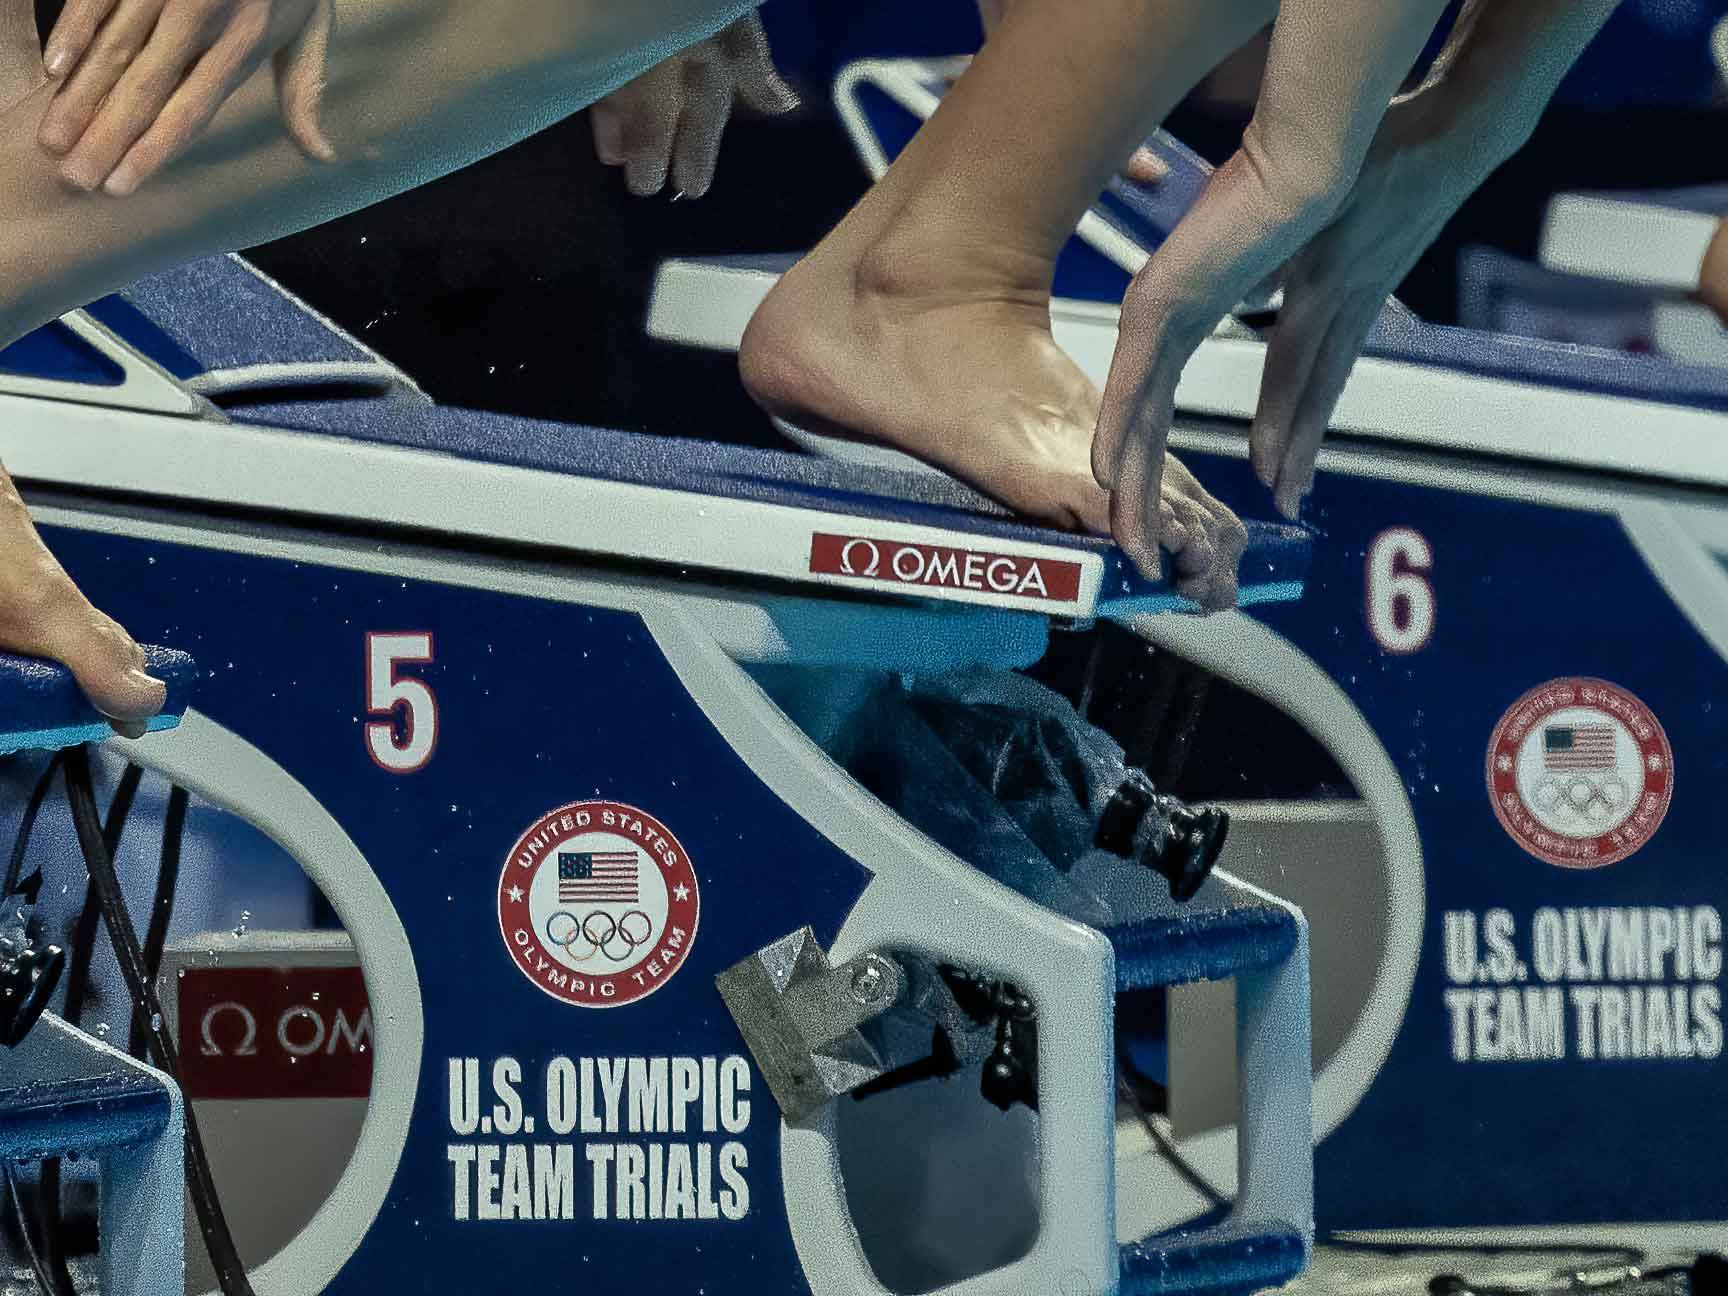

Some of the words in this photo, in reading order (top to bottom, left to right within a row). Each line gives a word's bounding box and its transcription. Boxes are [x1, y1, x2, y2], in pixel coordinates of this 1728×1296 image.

[891, 546, 1049, 598] OMEGA
[1366, 526, 1435, 654] 6
[363, 631, 439, 773] 5
[517, 810, 592, 868] UNITED
[601, 809, 677, 867] STATES
[514, 929, 616, 997] OLYMPIC
[631, 926, 686, 986] TEAM
[1444, 908, 1528, 984] U.S.
[1533, 906, 1723, 982] OLYMPIC
[277, 1006, 373, 1056] OM
[1444, 985, 1566, 1061] TEAM
[1571, 984, 1724, 1060] TRIALS
[448, 1056, 535, 1136] U.S.
[546, 1055, 752, 1135] OLYMPIC
[447, 1143, 574, 1221] TEAM
[585, 1141, 751, 1221] TRIALS
